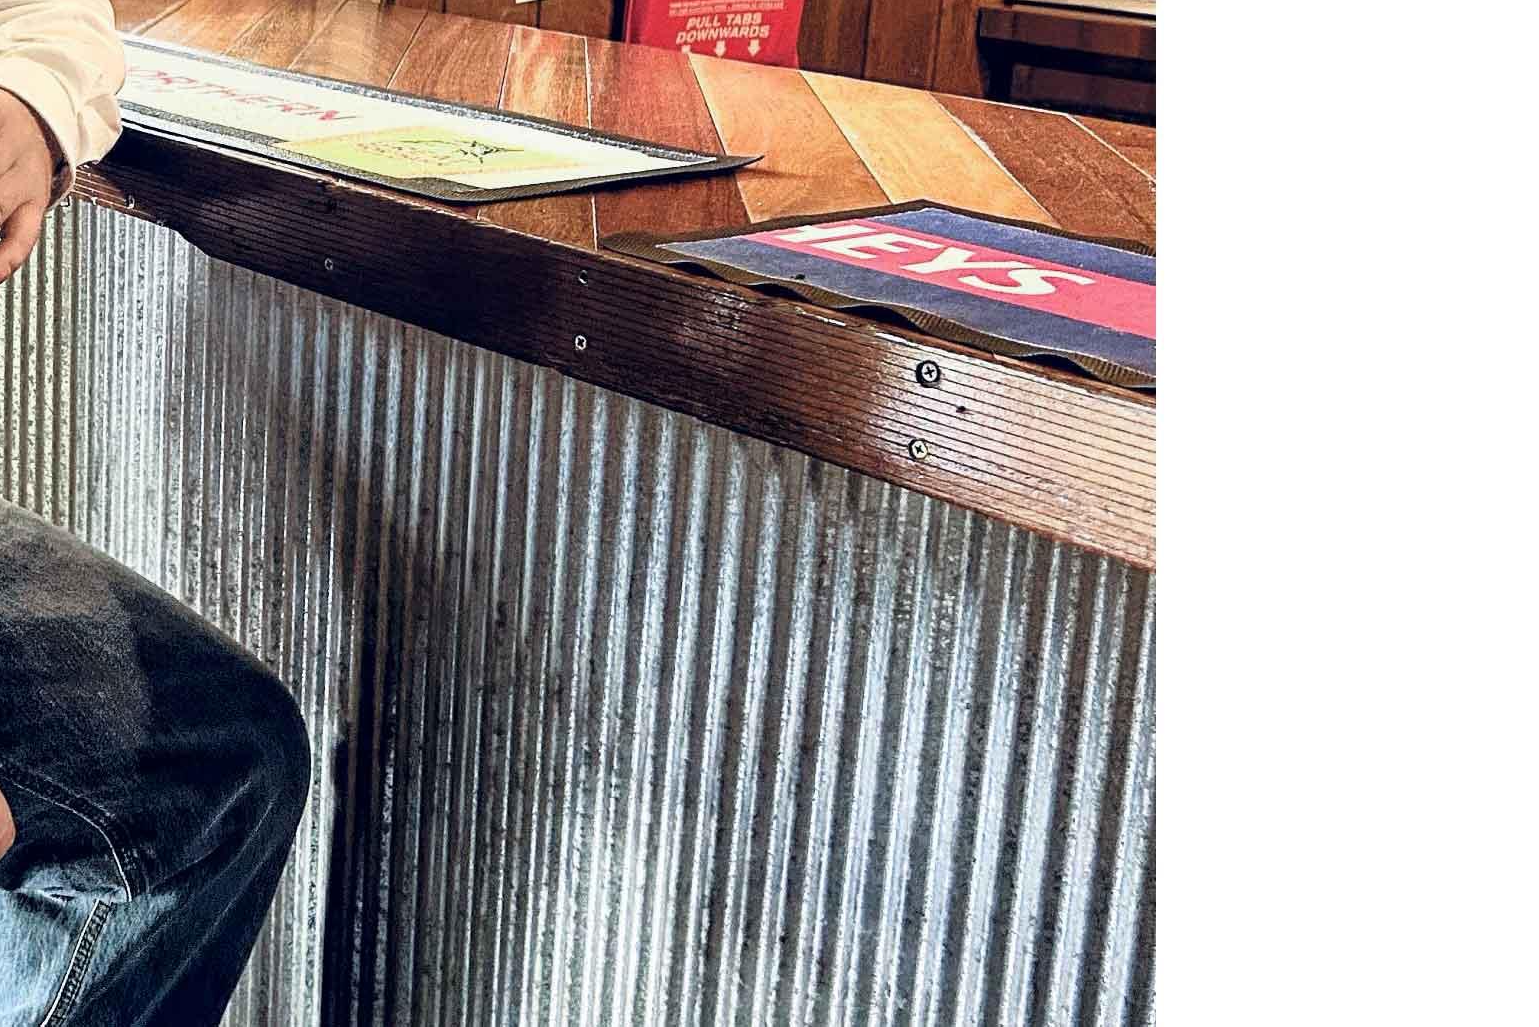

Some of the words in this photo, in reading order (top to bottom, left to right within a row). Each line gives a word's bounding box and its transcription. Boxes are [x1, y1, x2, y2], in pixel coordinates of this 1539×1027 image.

[686, 15, 721, 30] PULL
[726, 12, 763, 25] TABS
[676, 25, 770, 45] DOWNWARDS
